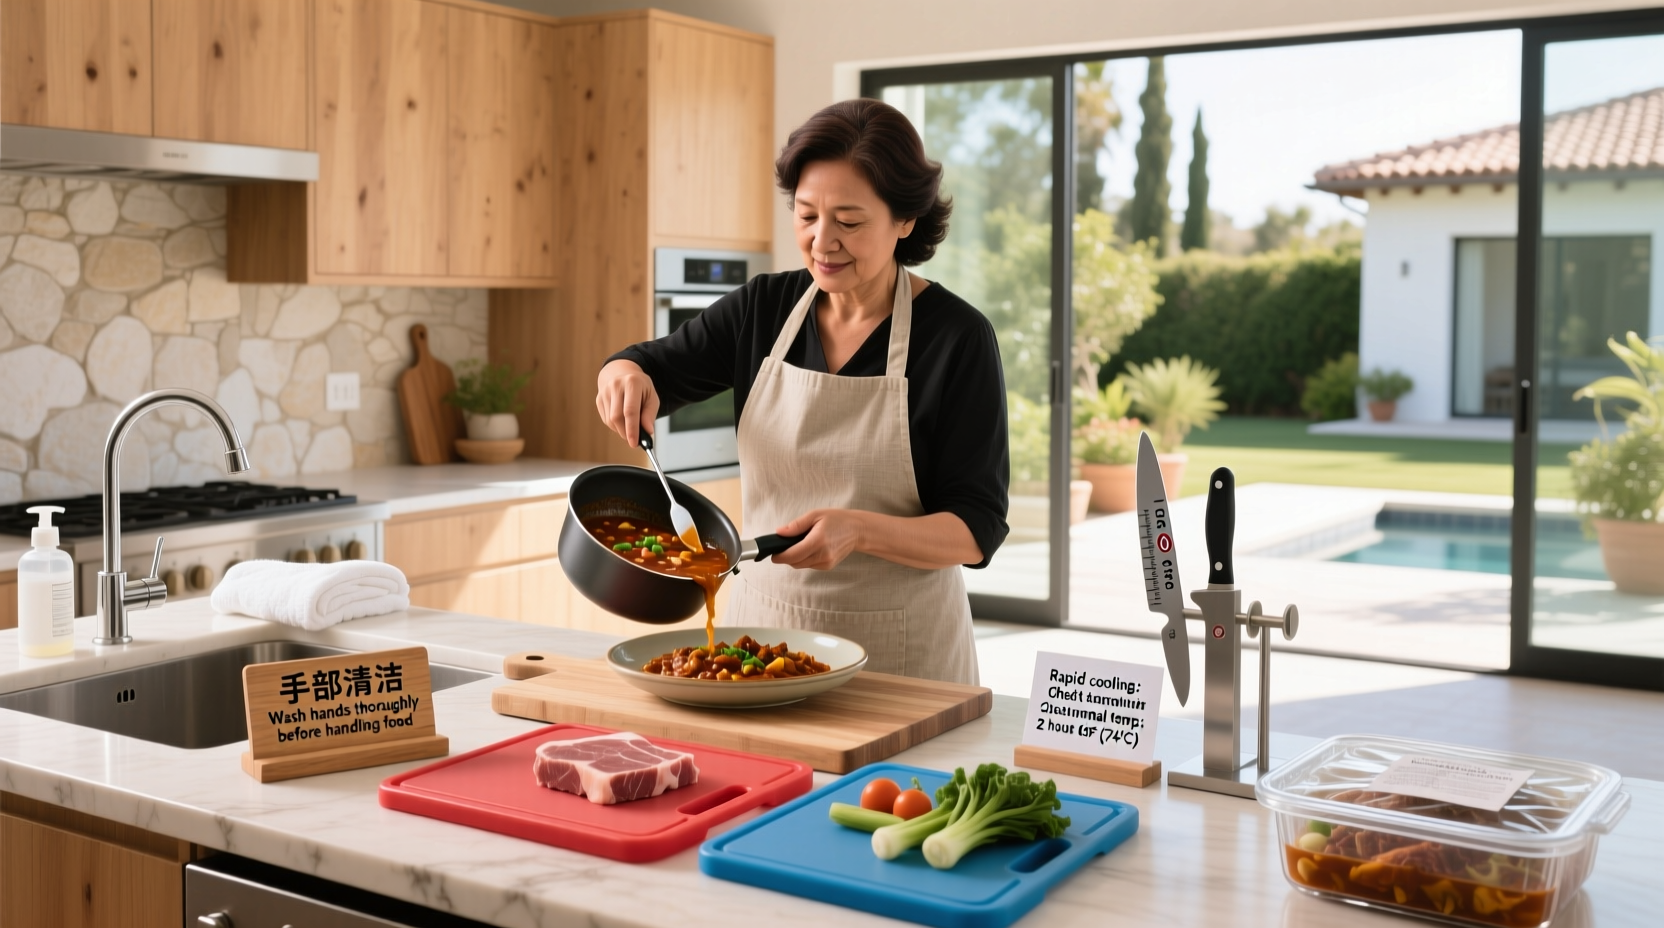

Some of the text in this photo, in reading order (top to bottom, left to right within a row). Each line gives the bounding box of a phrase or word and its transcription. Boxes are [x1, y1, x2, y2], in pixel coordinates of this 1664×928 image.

[279, 661, 403, 705] 手部清洁
[1049, 668, 1141, 695] Rapid cooling:
[268, 708, 306, 725] Wash
[310, 703, 352, 721] hands
[1036, 718, 1045, 731] 2
[277, 713, 413, 743] before handling food
